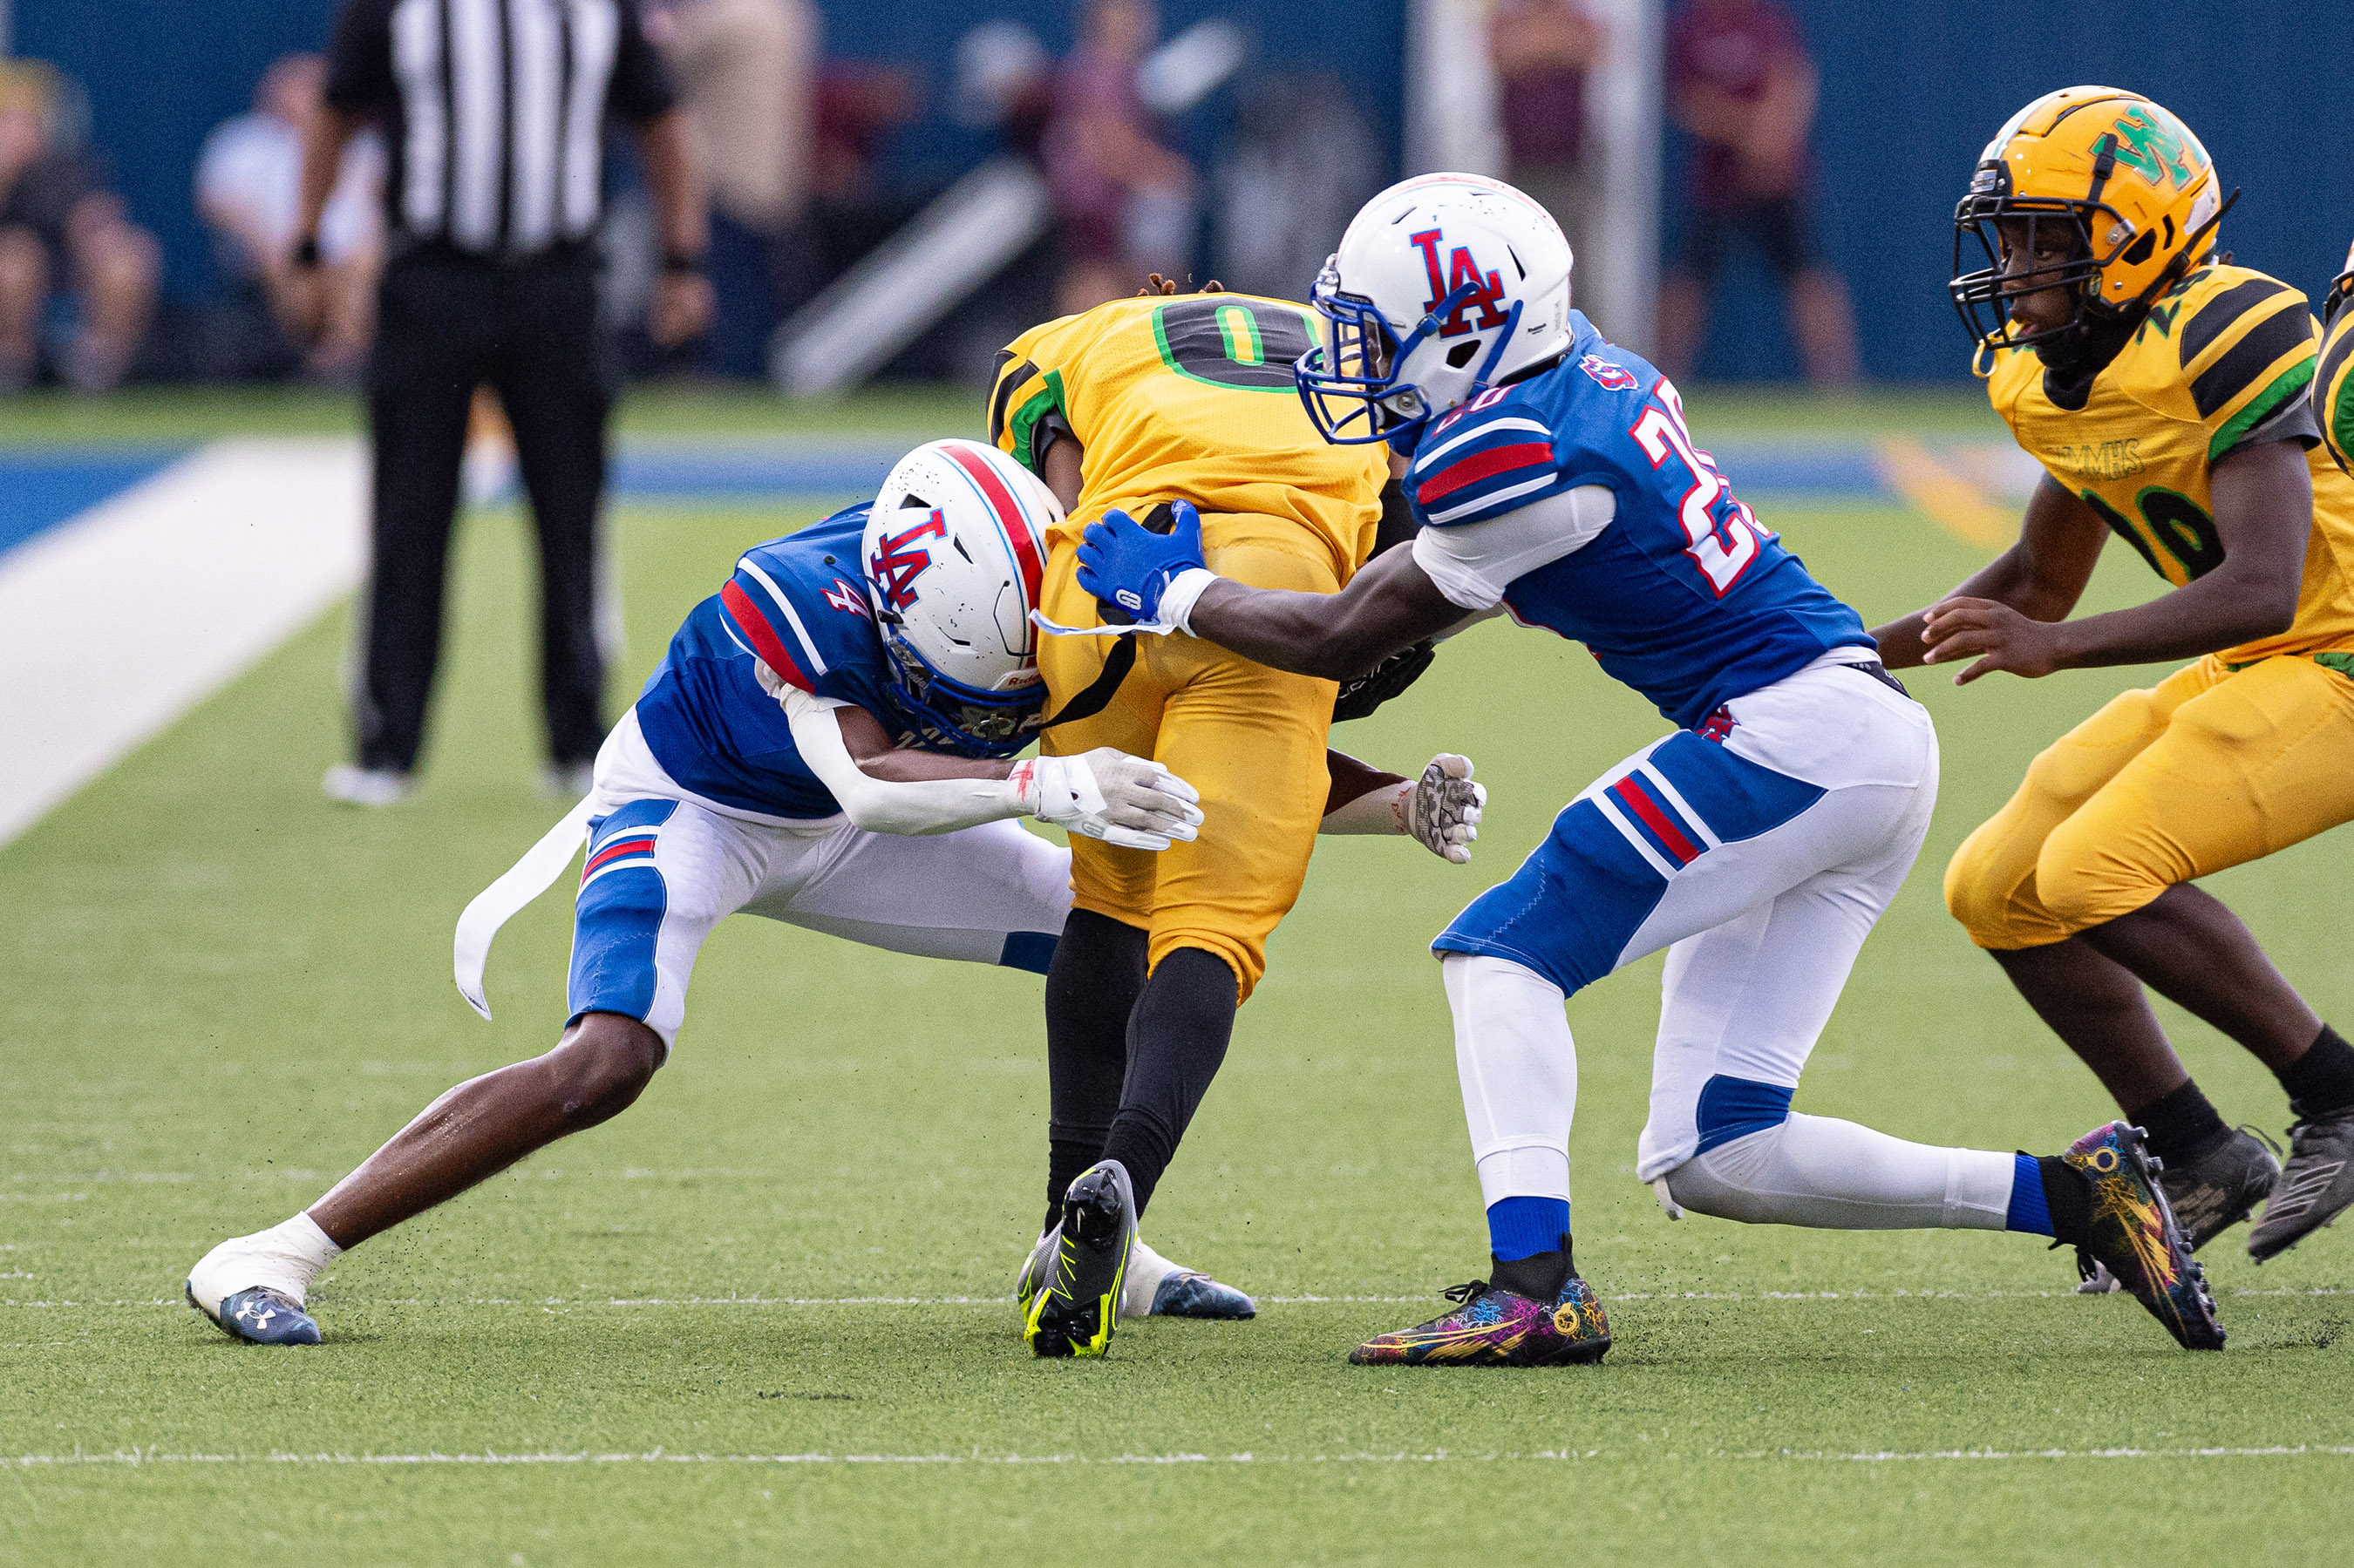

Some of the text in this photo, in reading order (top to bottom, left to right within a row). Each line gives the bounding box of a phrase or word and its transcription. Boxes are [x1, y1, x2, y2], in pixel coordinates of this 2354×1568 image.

[1409, 227, 1511, 340] LA
[1151, 295, 1325, 395] 0
[819, 577, 873, 625] 4
[869, 506, 949, 613] LA
